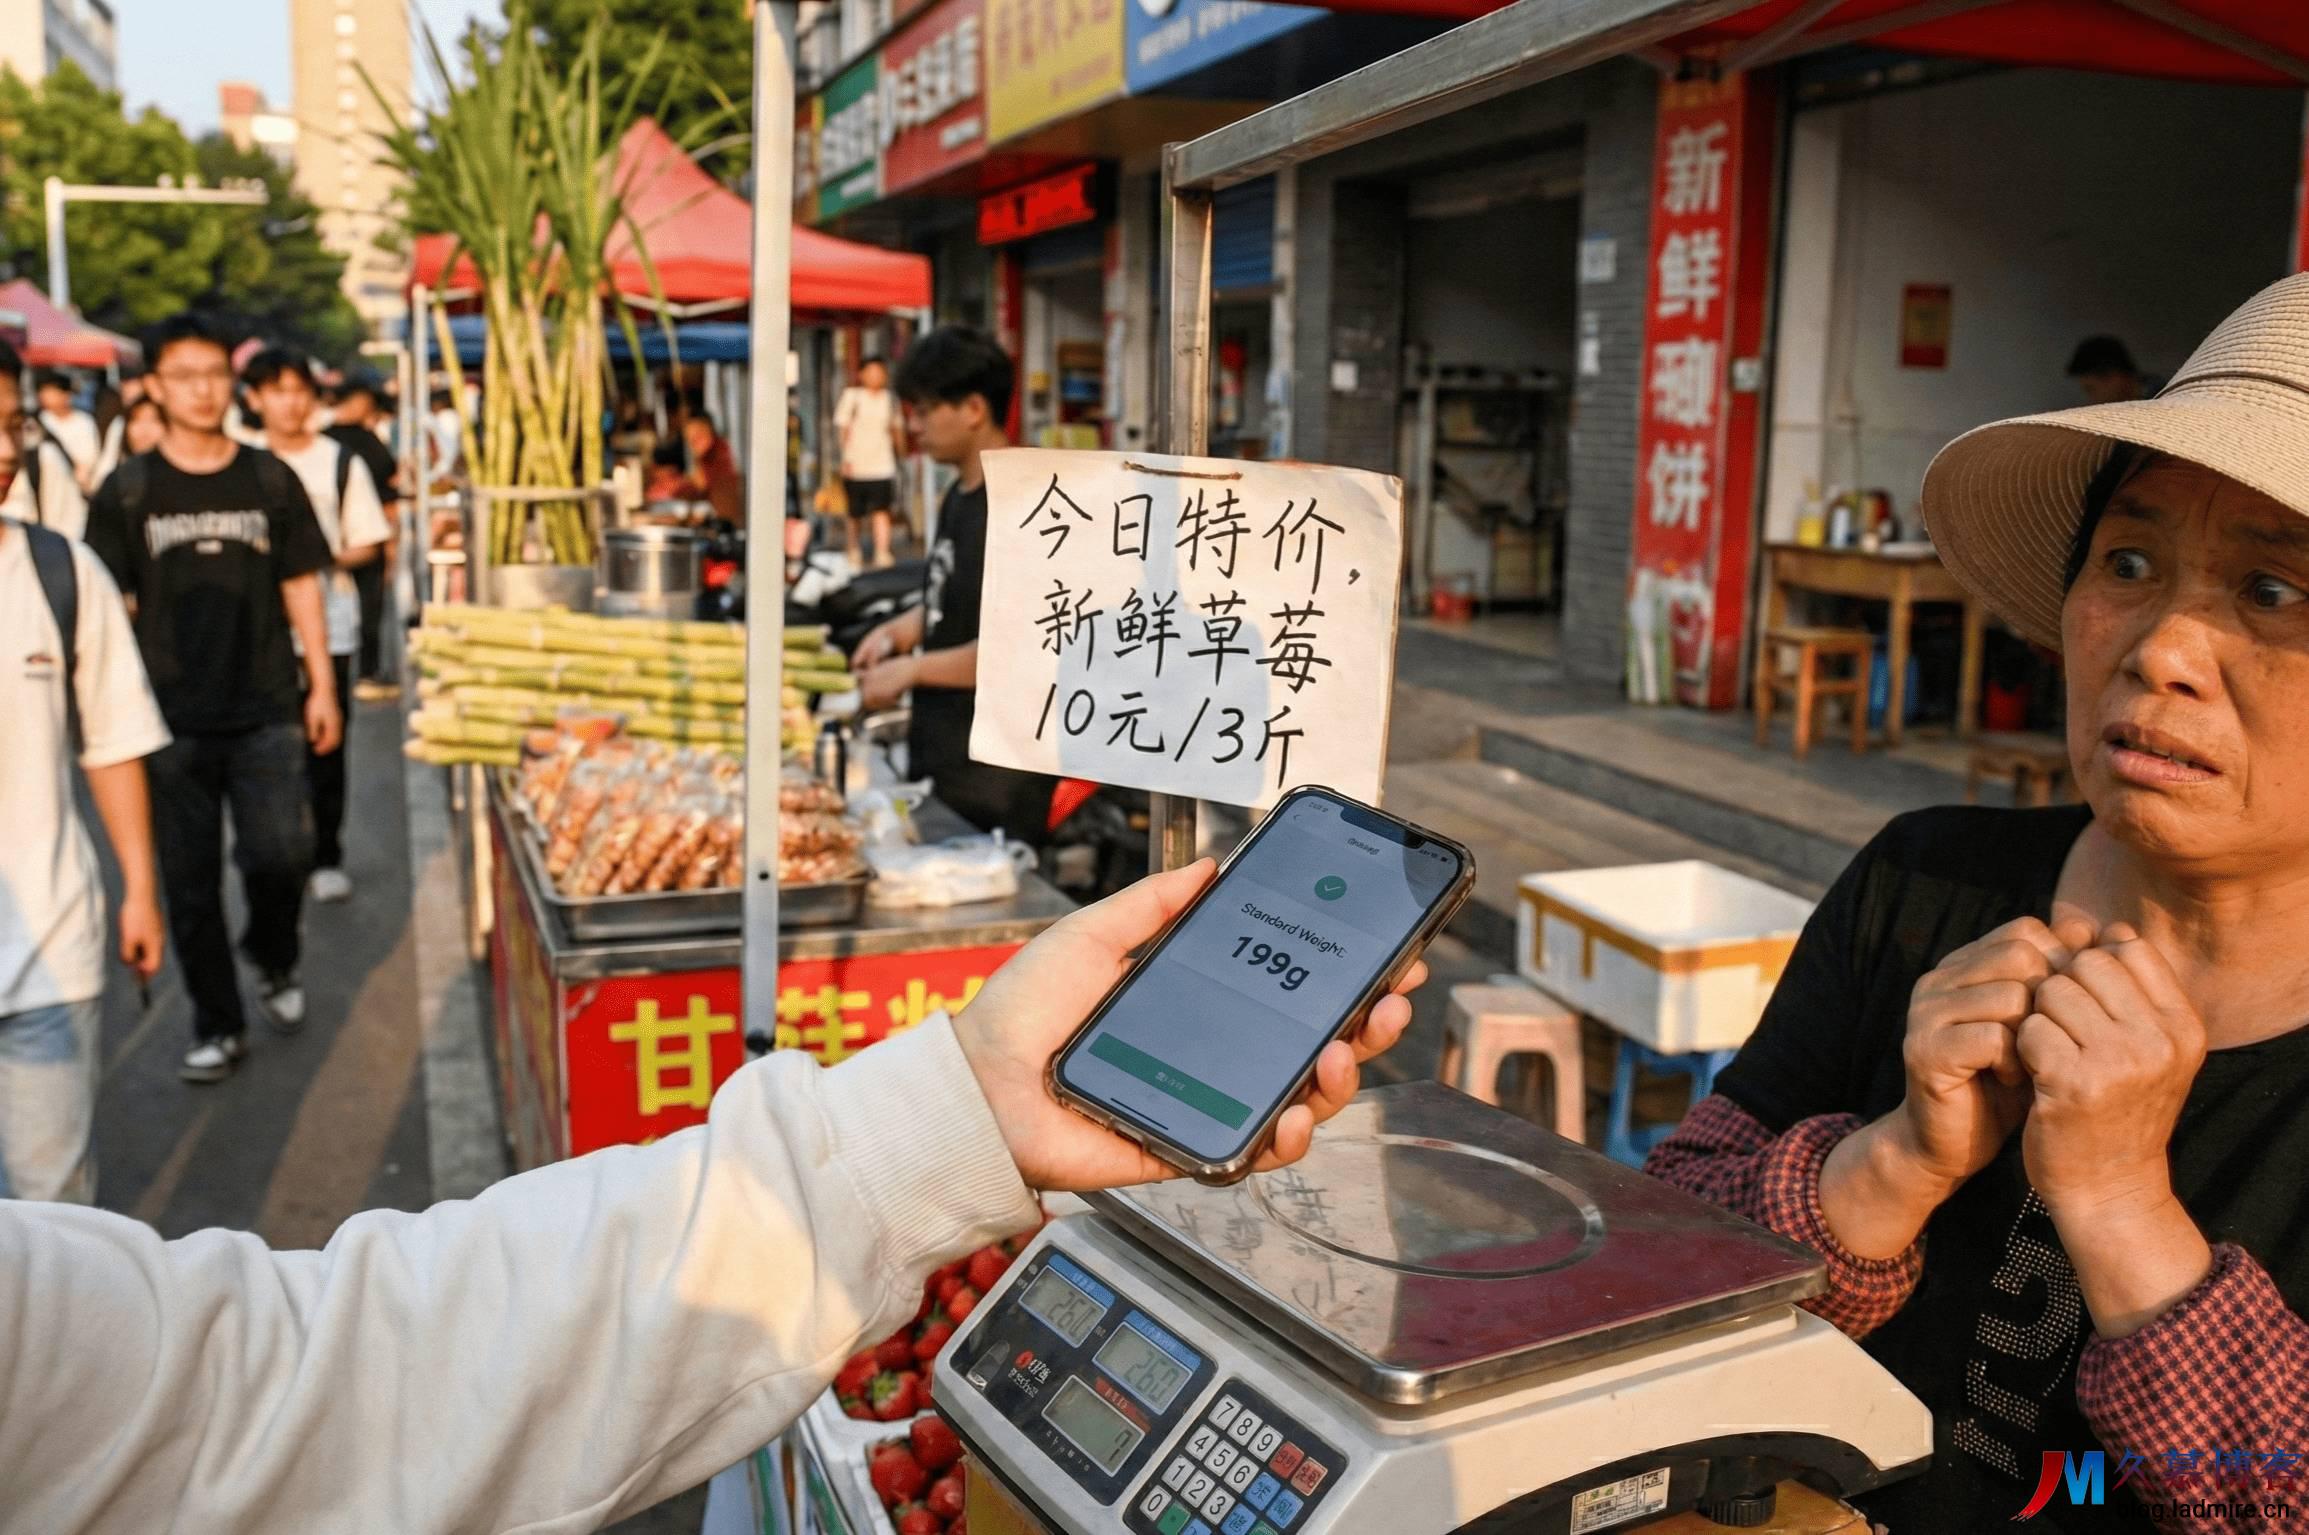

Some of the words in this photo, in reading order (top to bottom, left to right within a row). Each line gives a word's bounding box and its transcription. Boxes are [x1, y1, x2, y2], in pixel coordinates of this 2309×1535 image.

[1035, 579, 1332, 693] 新鲜草莓
[1036, 683, 1304, 788] 10元/3斤
[1241, 903, 1300, 935] Standard
[1231, 936, 1310, 991] 199g
[1217, 1401, 1234, 1420] 7
[1237, 1417, 1254, 1436] 8
[1257, 1433, 1274, 1452] 9
[1194, 1435, 1210, 1452] 4
[1213, 1449, 1231, 1467] 5
[1233, 1465, 1250, 1484] 6
[1150, 1493, 1163, 1512] 0
[1171, 1464, 1186, 1481] 1
[1188, 1479, 1206, 1499] 2
[1209, 1495, 1226, 1515] 3
